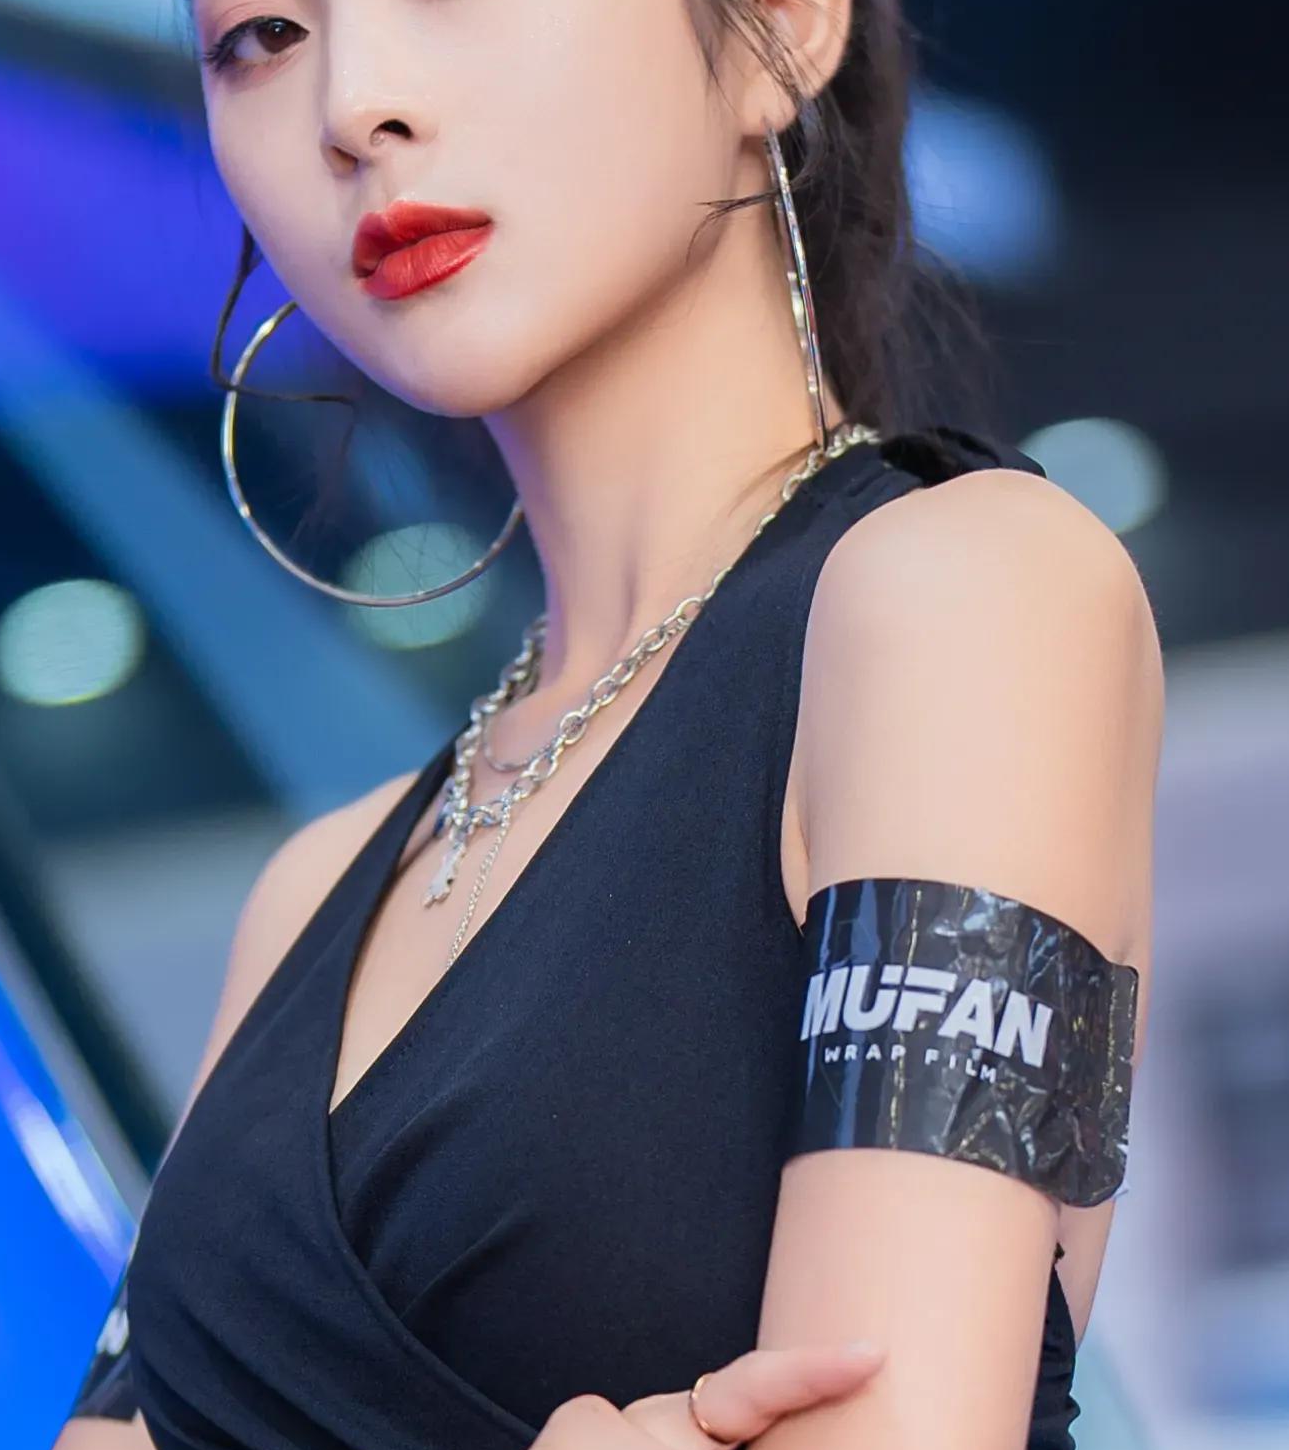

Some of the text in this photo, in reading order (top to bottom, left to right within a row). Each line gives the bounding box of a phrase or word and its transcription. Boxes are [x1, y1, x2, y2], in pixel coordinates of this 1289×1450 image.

[800, 964, 1053, 1068] MUFAN
[824, 1044, 997, 1084] WRAP FILM
